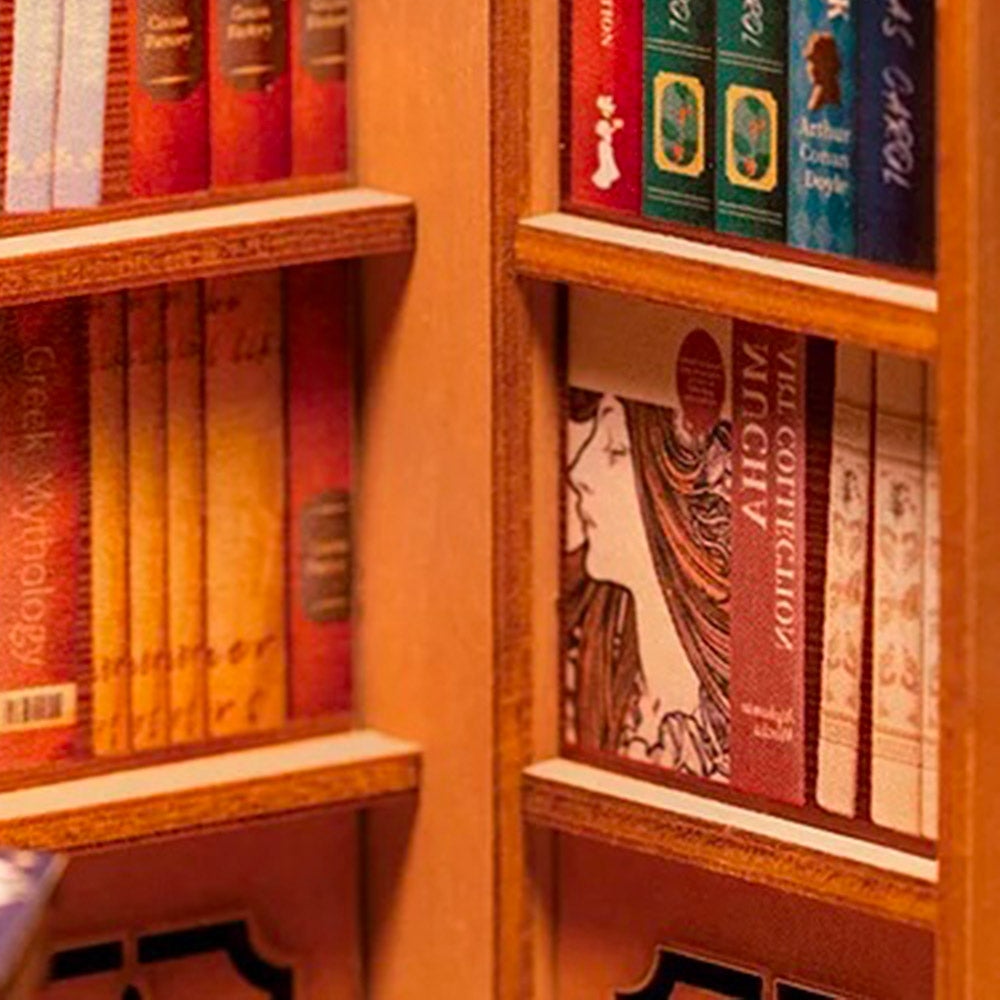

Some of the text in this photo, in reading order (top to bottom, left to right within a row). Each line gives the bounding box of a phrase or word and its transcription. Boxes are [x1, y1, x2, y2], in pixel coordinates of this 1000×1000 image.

[882, 66, 915, 190] CAROL
[8, 345, 56, 669] Greek Mythology
